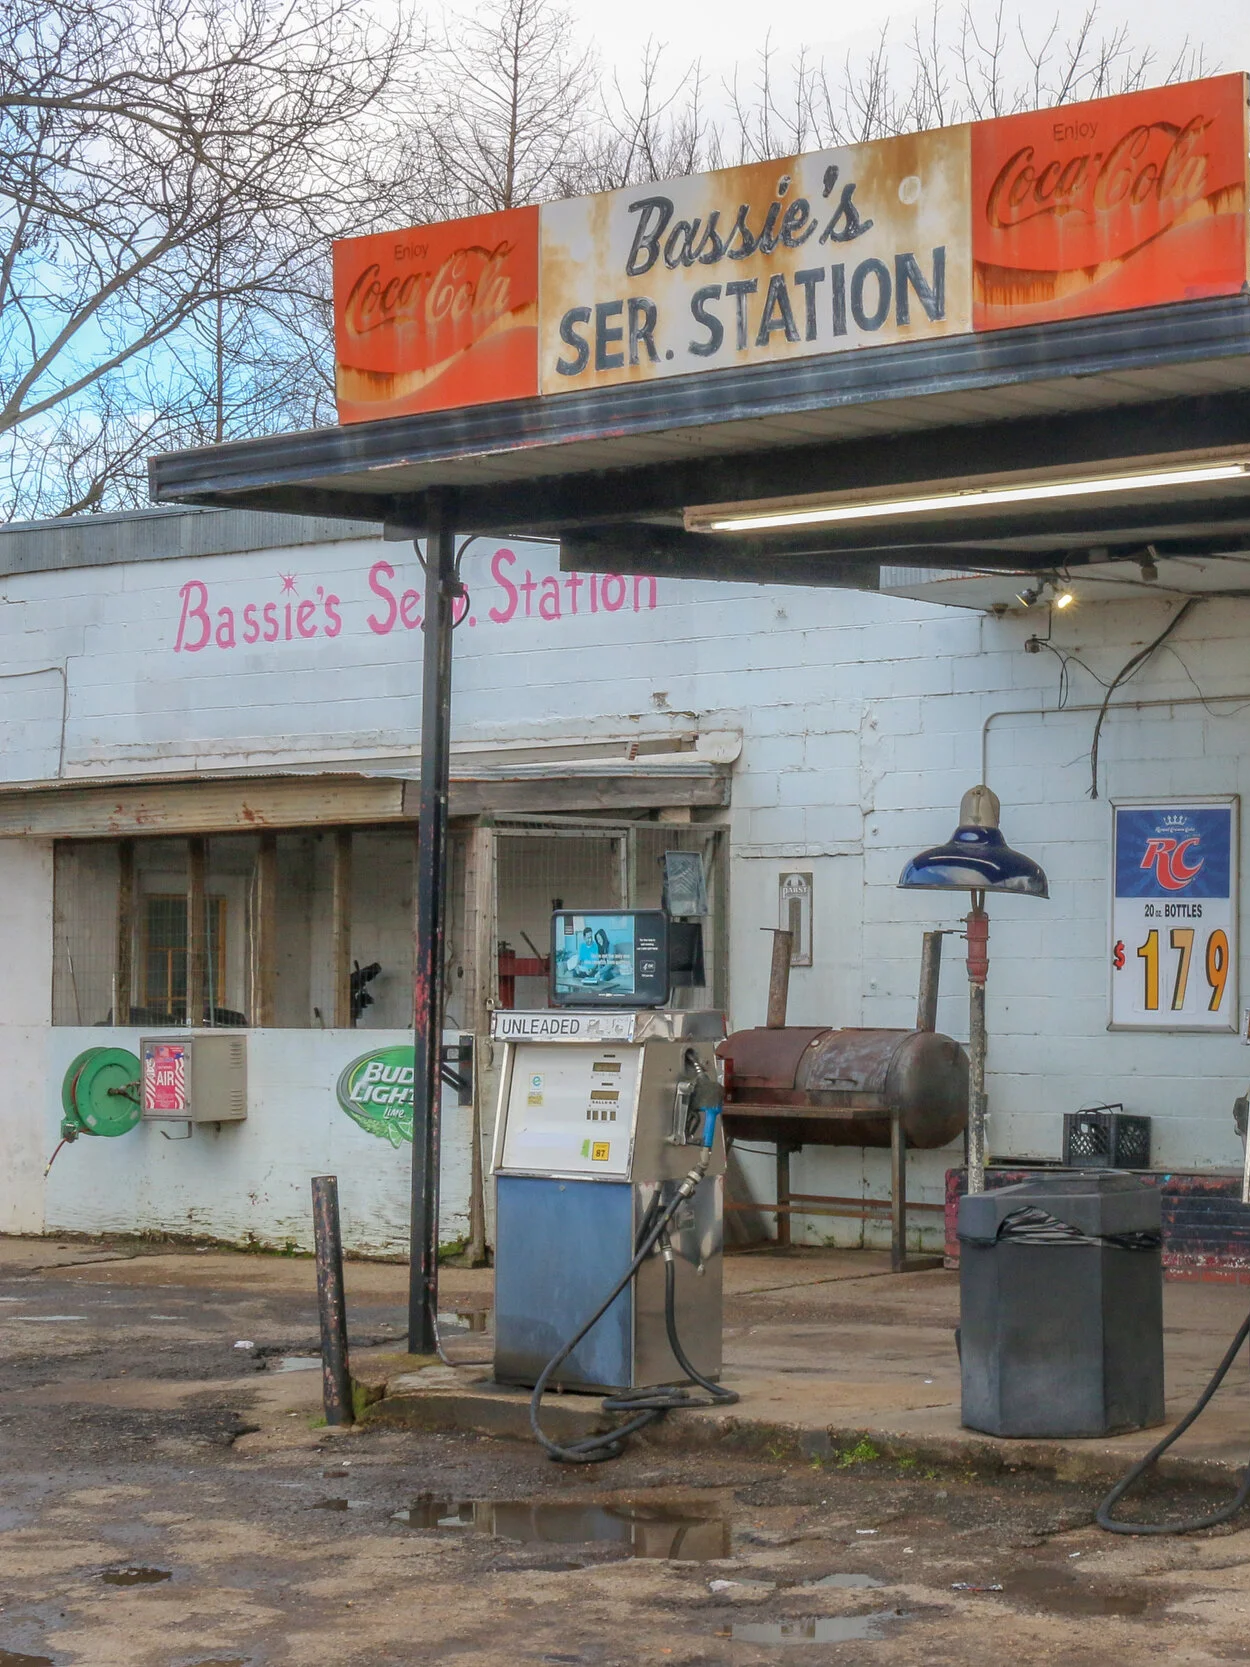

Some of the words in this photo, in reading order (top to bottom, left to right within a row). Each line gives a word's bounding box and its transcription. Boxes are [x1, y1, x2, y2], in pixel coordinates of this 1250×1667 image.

[1053, 121, 1098, 141] Enjoy
[625, 165, 874, 277] Bassie's
[394, 242, 429, 260] Enjoy
[555, 297, 675, 377] SER.
[688, 246, 947, 358] STATION
[173, 574, 343, 653] Bassie's
[366, 560, 477, 635] Sev.
[488, 548, 657, 624] Station
[1140, 837, 1204, 891] RC
[1144, 904, 1155, 917] 20
[1164, 903, 1203, 918] BOTTLES
[502, 1019, 580, 1034] UNLEADED
[156, 1070, 175, 1086] AIR
[361, 1062, 415, 1085] BUD
[595, 1150, 605, 1158] 87
